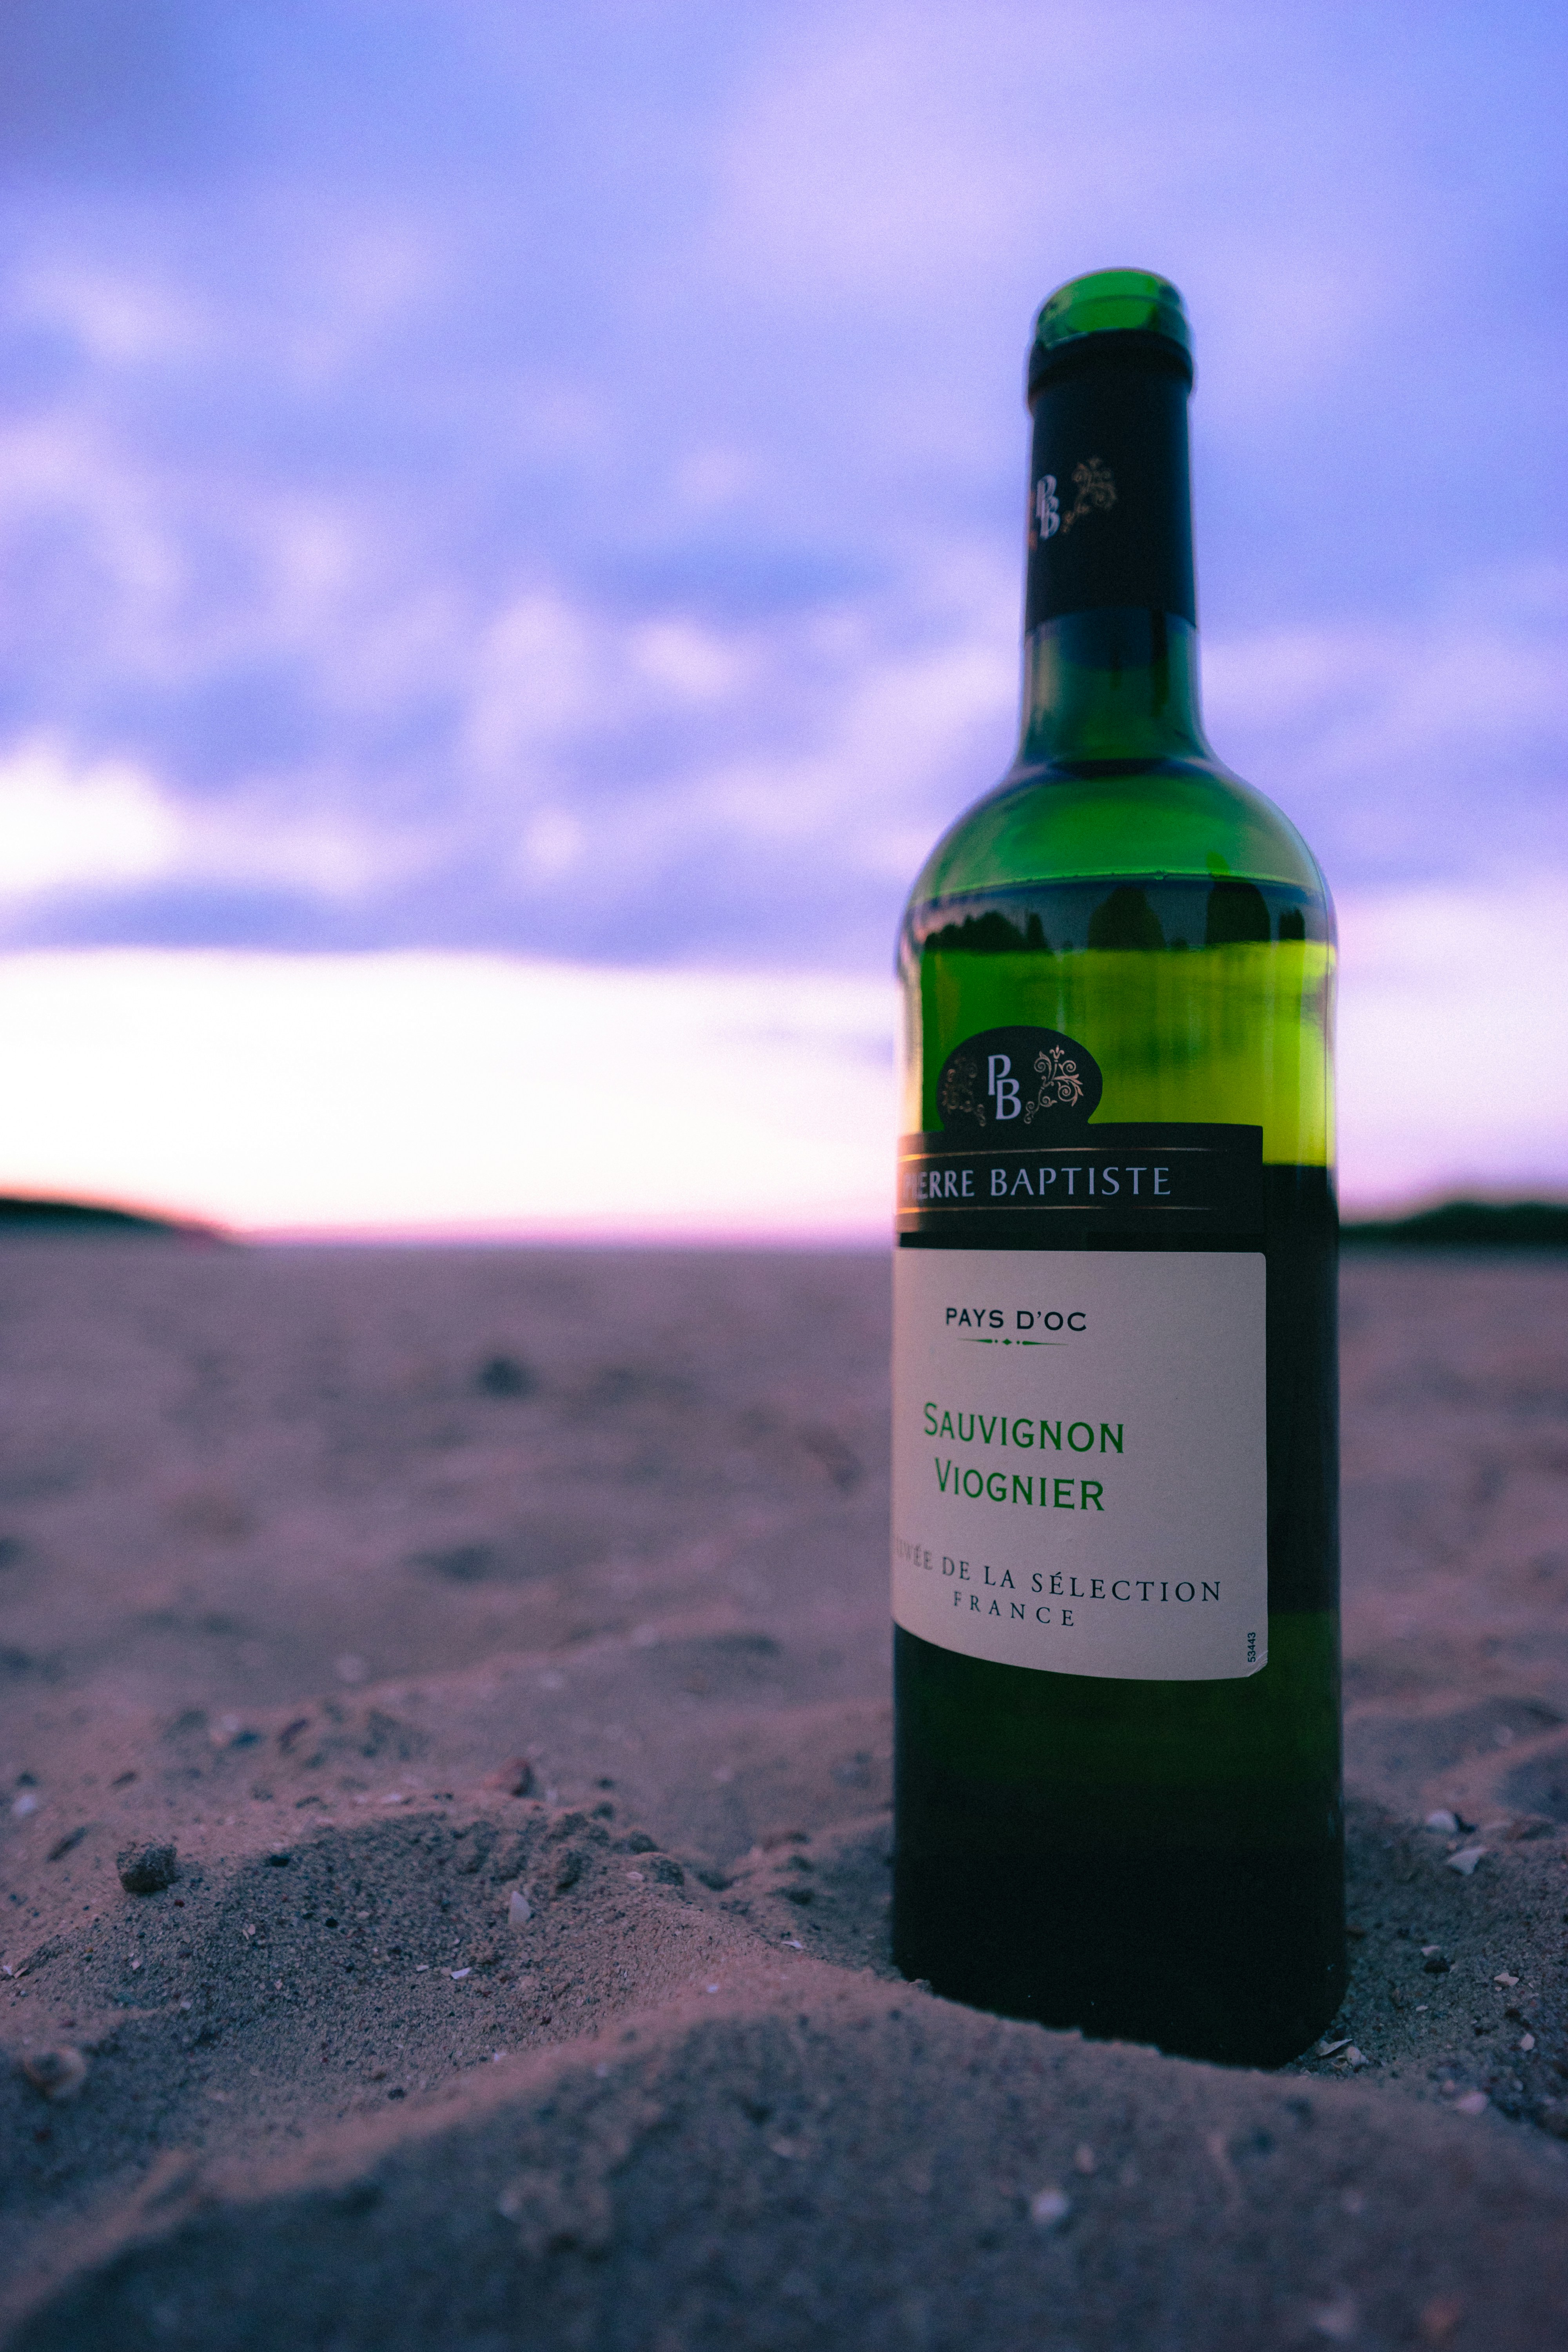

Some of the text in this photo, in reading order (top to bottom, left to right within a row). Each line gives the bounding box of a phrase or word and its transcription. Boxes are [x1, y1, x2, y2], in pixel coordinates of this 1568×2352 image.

[987, 1054, 1022, 1120] PB
[990, 1167, 1171, 1196] BAPTISTE
[946, 1308, 1087, 1332] PAYS D'OC
[924, 1402, 1124, 1454] SAUVIGNON
[935, 1457, 1105, 1511] VIOGNIER
[942, 1556, 971, 1581] DE
[984, 1566, 1016, 1589] LA
[1031, 1571, 1221, 1602] SÉLECTION
[953, 1591, 1074, 1627] FRANCE
[1247, 1632, 1256, 1662] 53443
